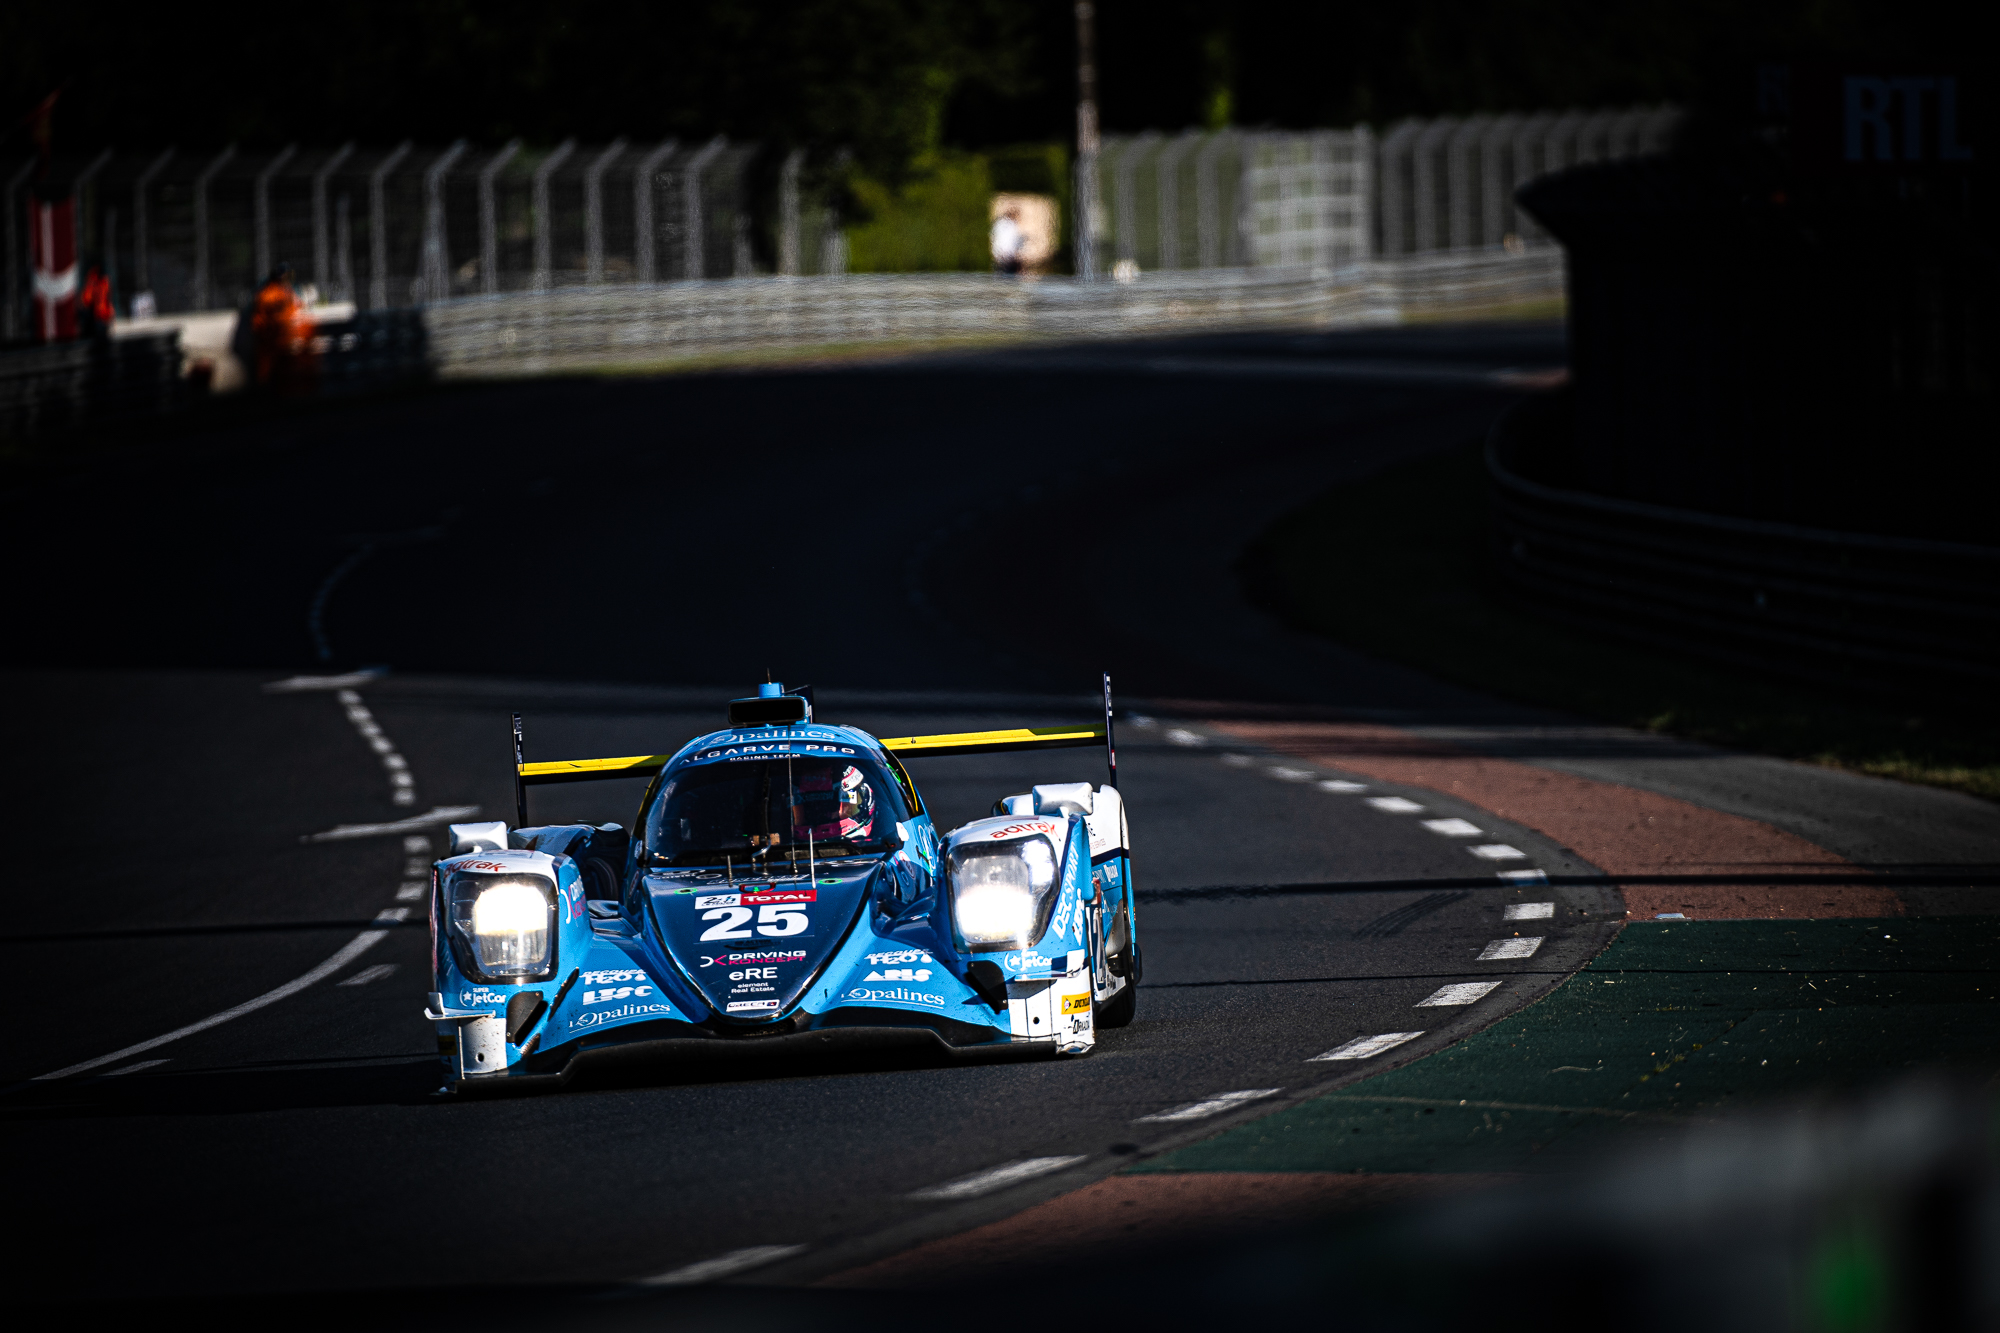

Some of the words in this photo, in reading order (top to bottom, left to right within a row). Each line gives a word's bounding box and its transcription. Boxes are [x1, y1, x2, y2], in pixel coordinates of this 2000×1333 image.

[1842, 74, 1974, 163] RTL
[679, 744, 791, 766] ALGARVE
[805, 744, 856, 755] PRO
[743, 893, 812, 902] TOTAL
[699, 903, 810, 942] 25
[728, 950, 807, 961] DRIVING
[728, 955, 806, 966] KONCEPT
[728, 966, 779, 981] eRE
